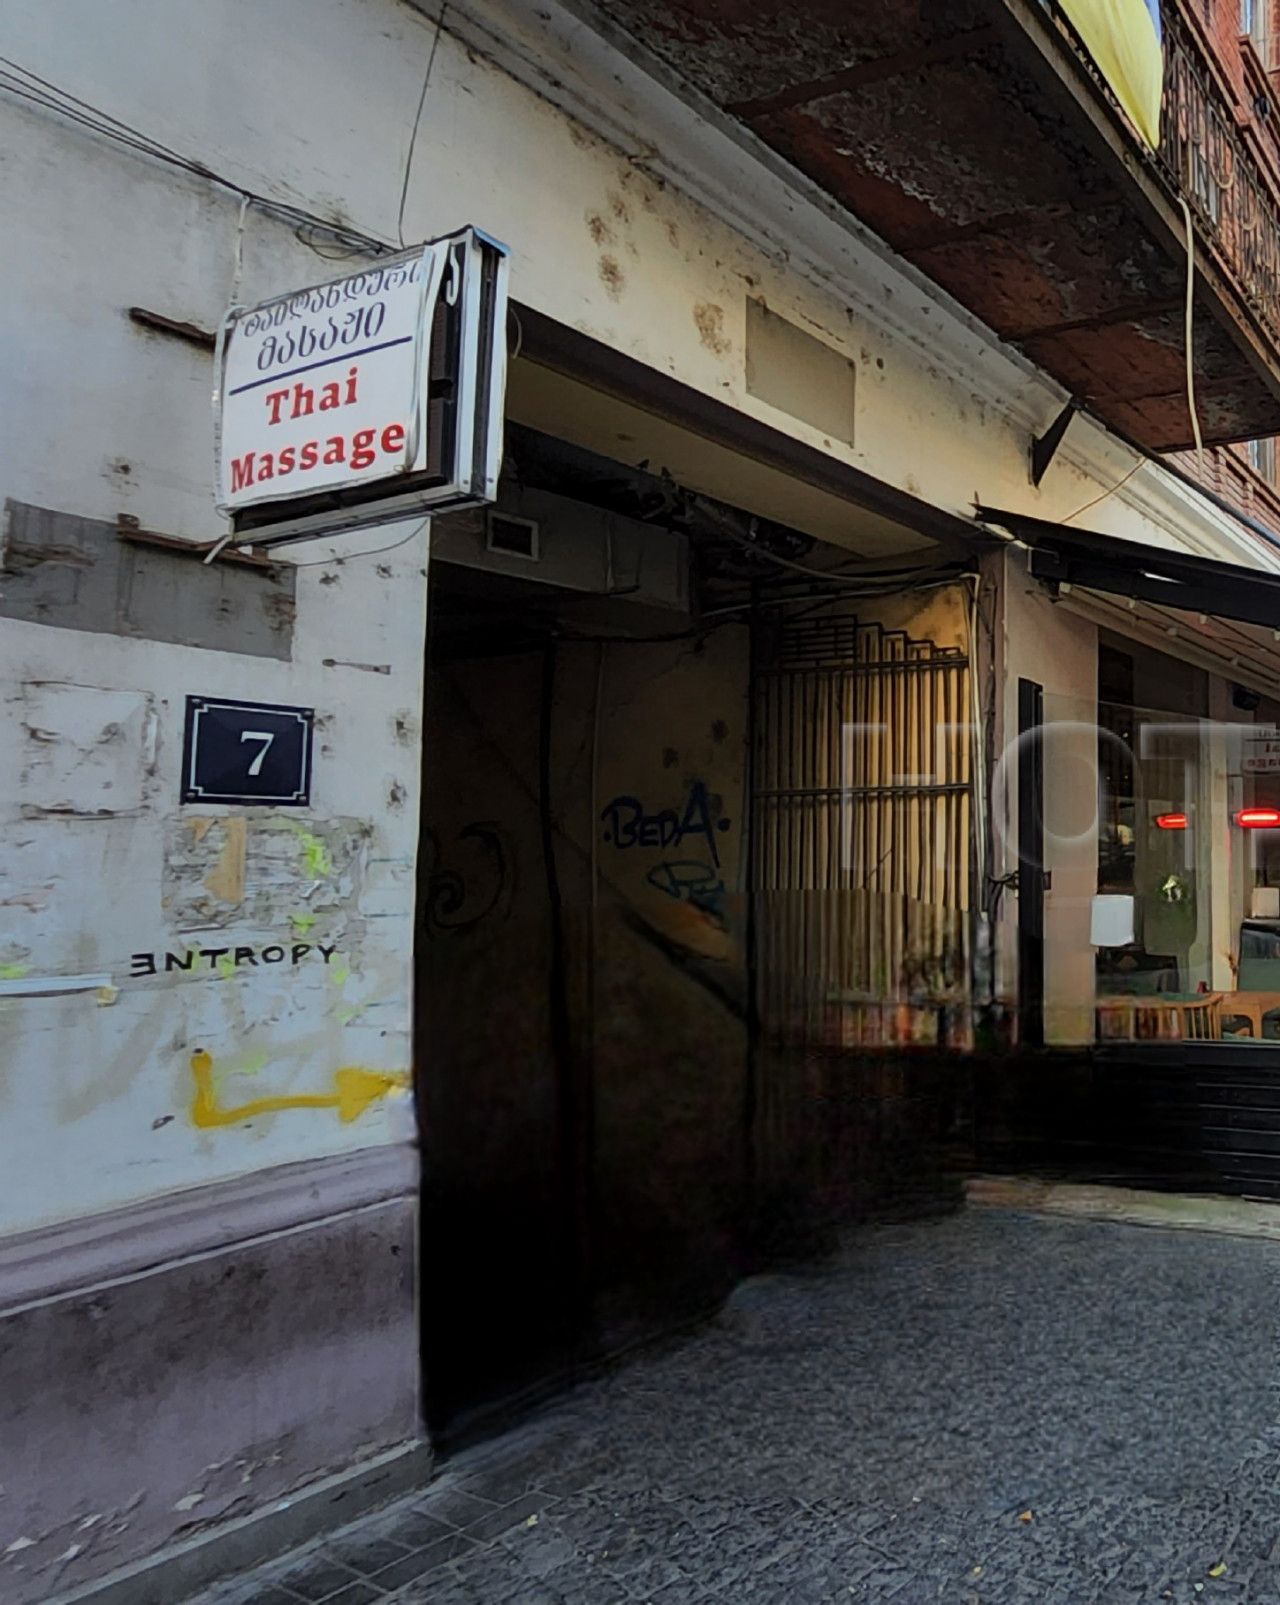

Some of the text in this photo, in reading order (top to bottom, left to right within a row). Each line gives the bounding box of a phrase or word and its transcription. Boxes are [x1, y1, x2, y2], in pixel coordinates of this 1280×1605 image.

[257, 301, 386, 371] მასაჟი
[265, 366, 358, 426] Thai
[230, 423, 405, 494] Massage
[240, 731, 276, 776] 7
